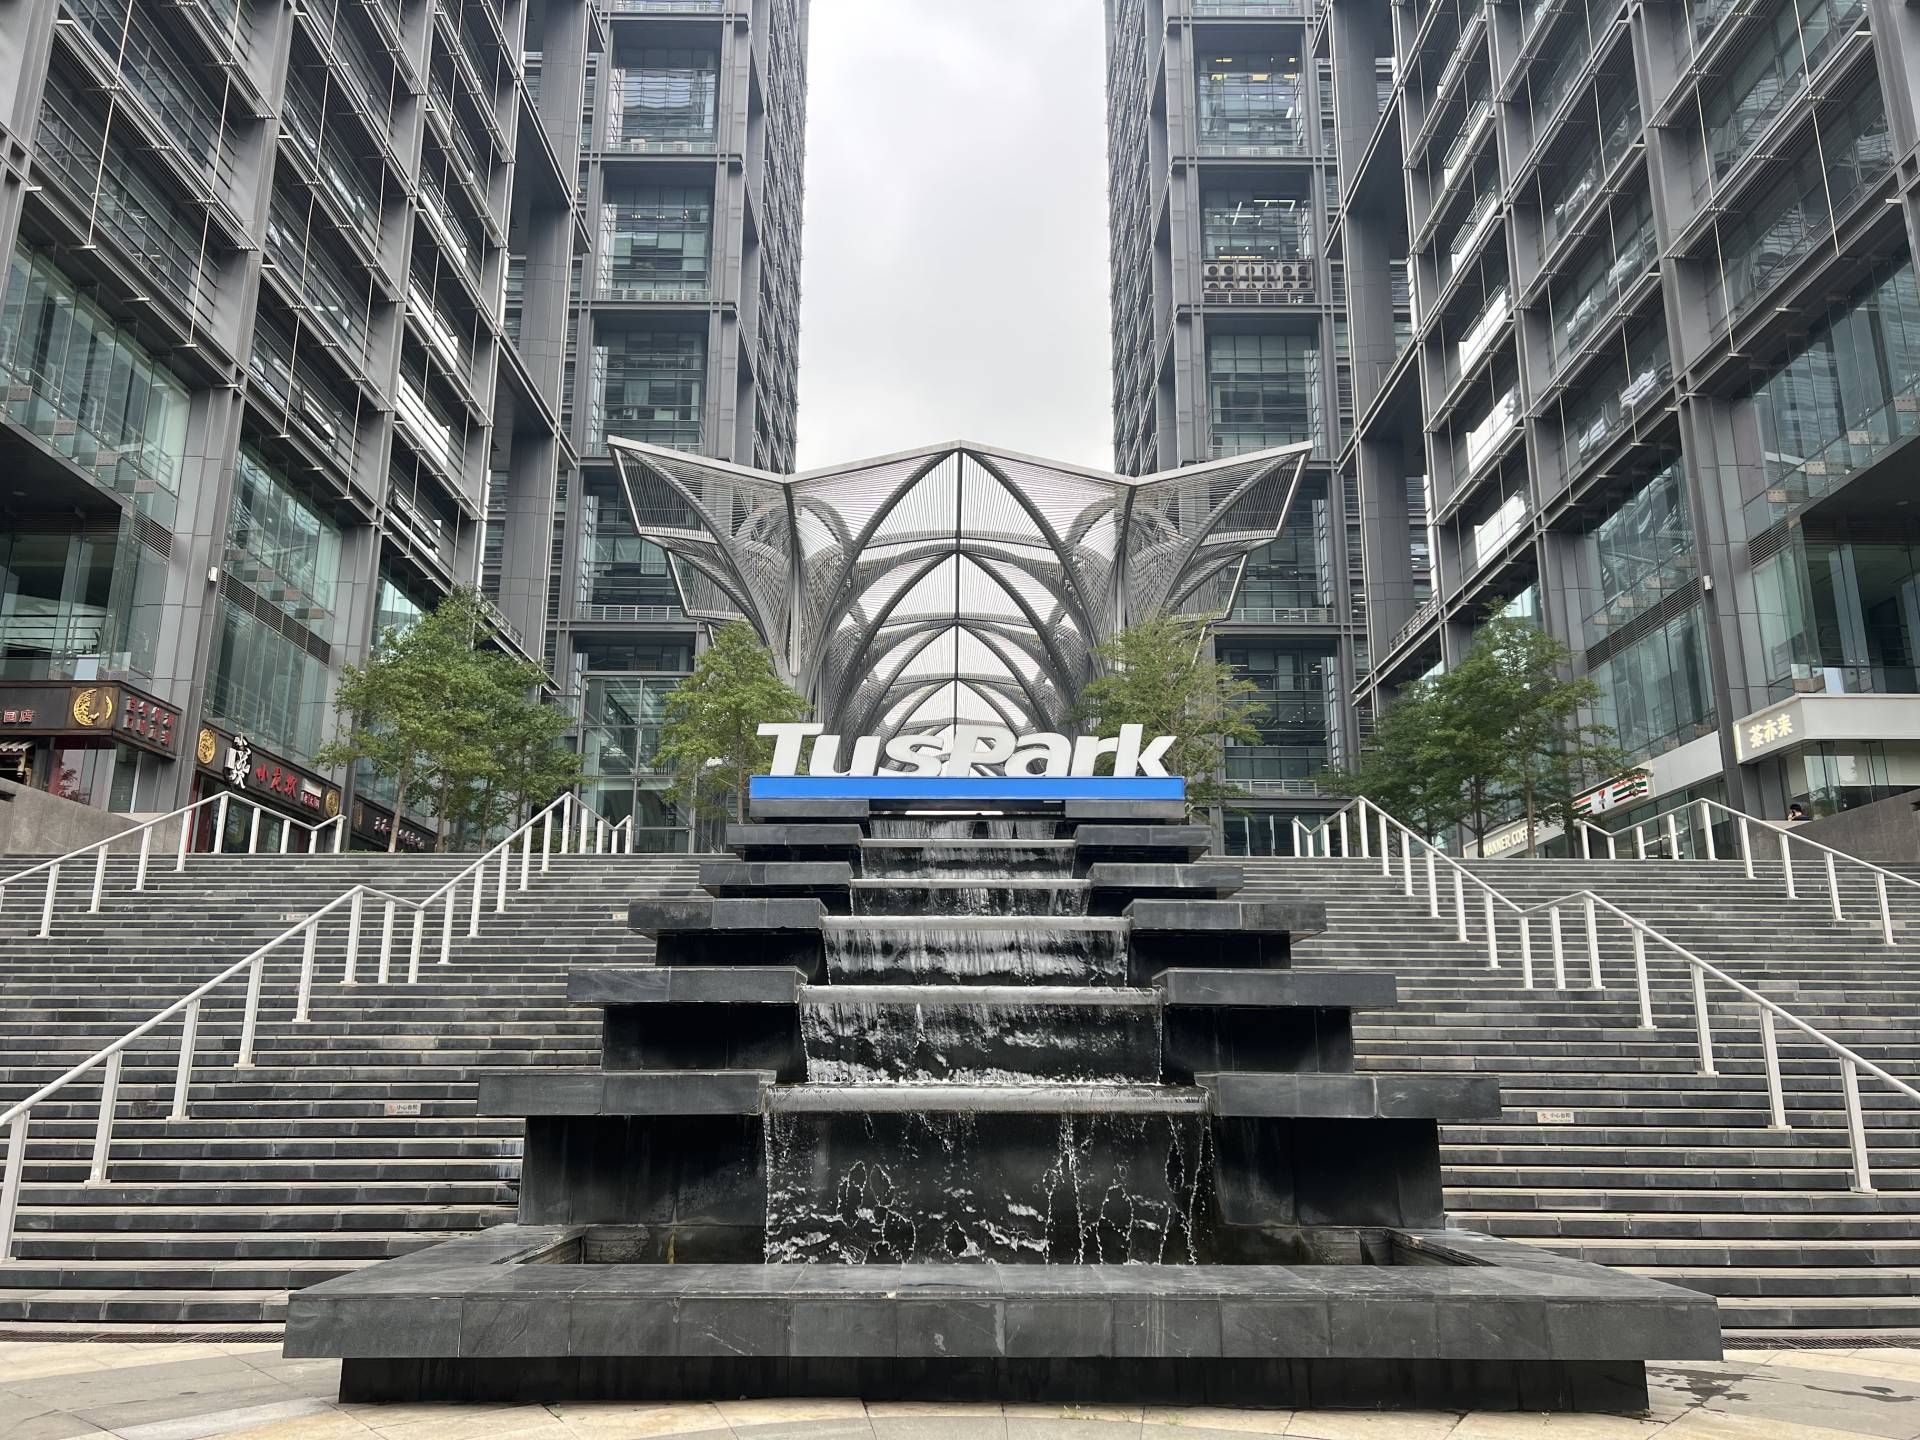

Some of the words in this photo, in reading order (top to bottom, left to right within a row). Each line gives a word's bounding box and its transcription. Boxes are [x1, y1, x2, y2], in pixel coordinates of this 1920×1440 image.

[1748, 713, 1793, 749] 茶亦来
[756, 722, 1178, 777] TusPark
[1511, 825, 1539, 846] COFFE
